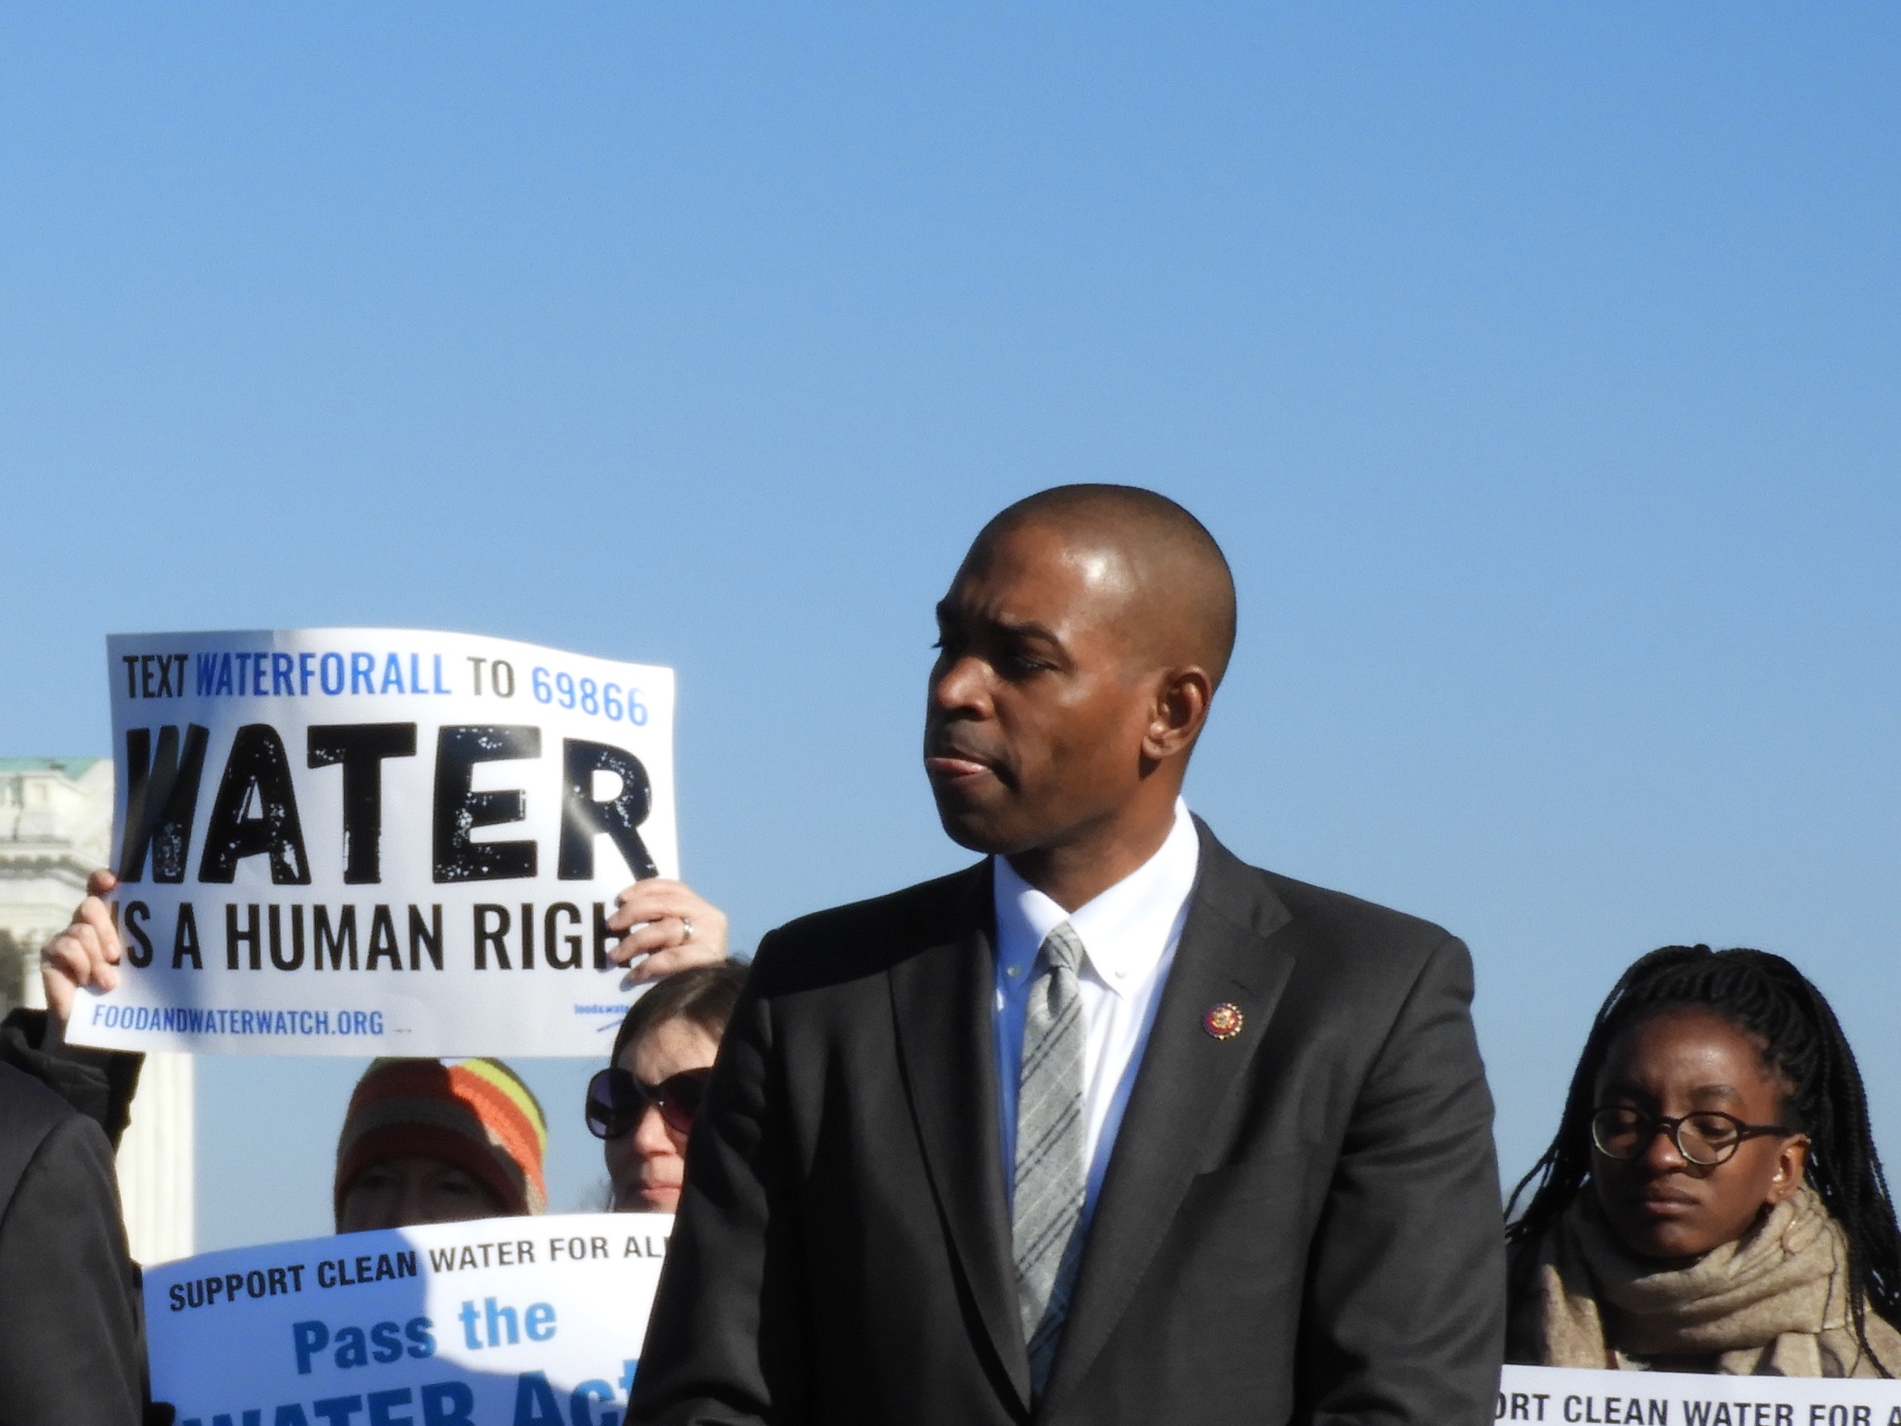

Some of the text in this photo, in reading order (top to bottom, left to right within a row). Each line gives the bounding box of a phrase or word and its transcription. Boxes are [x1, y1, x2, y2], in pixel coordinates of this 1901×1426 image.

[123, 652, 649, 727] TEXT WATERFORALL TO 69866
[124, 722, 659, 885] WATER
[171, 902, 204, 970] A
[226, 903, 444, 972] HUMAN
[474, 901, 631, 971] RIGH
[92, 1004, 384, 1037] FOODANDWATERWATCH.ORG
[169, 1264, 306, 1312] SUPPORT
[318, 1251, 418, 1289] CLEAN
[430, 1240, 536, 1275] WATER
[550, 1237, 610, 1262] FOR
[293, 1297, 558, 1375] Pass the
[1564, 1394, 1669, 1426] CLEAN
